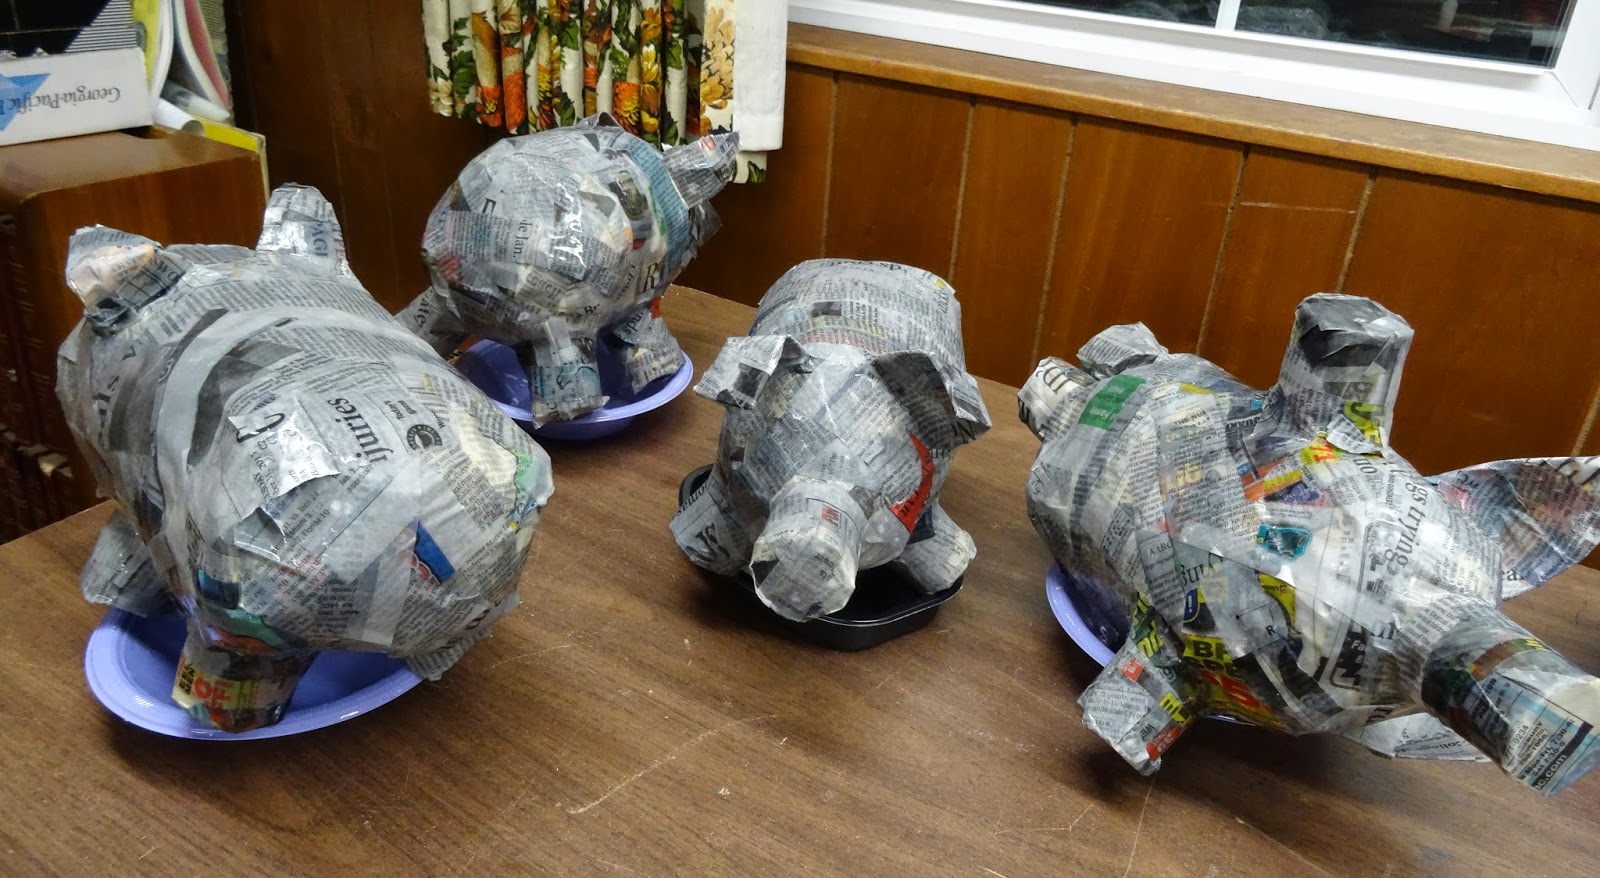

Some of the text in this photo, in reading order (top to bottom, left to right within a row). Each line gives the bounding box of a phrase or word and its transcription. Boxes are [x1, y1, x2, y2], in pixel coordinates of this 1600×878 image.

[8, 85, 121, 114] Georgia-Pacific
[511, 234, 528, 259] Jan.
[1384, 505, 1427, 569] trying
